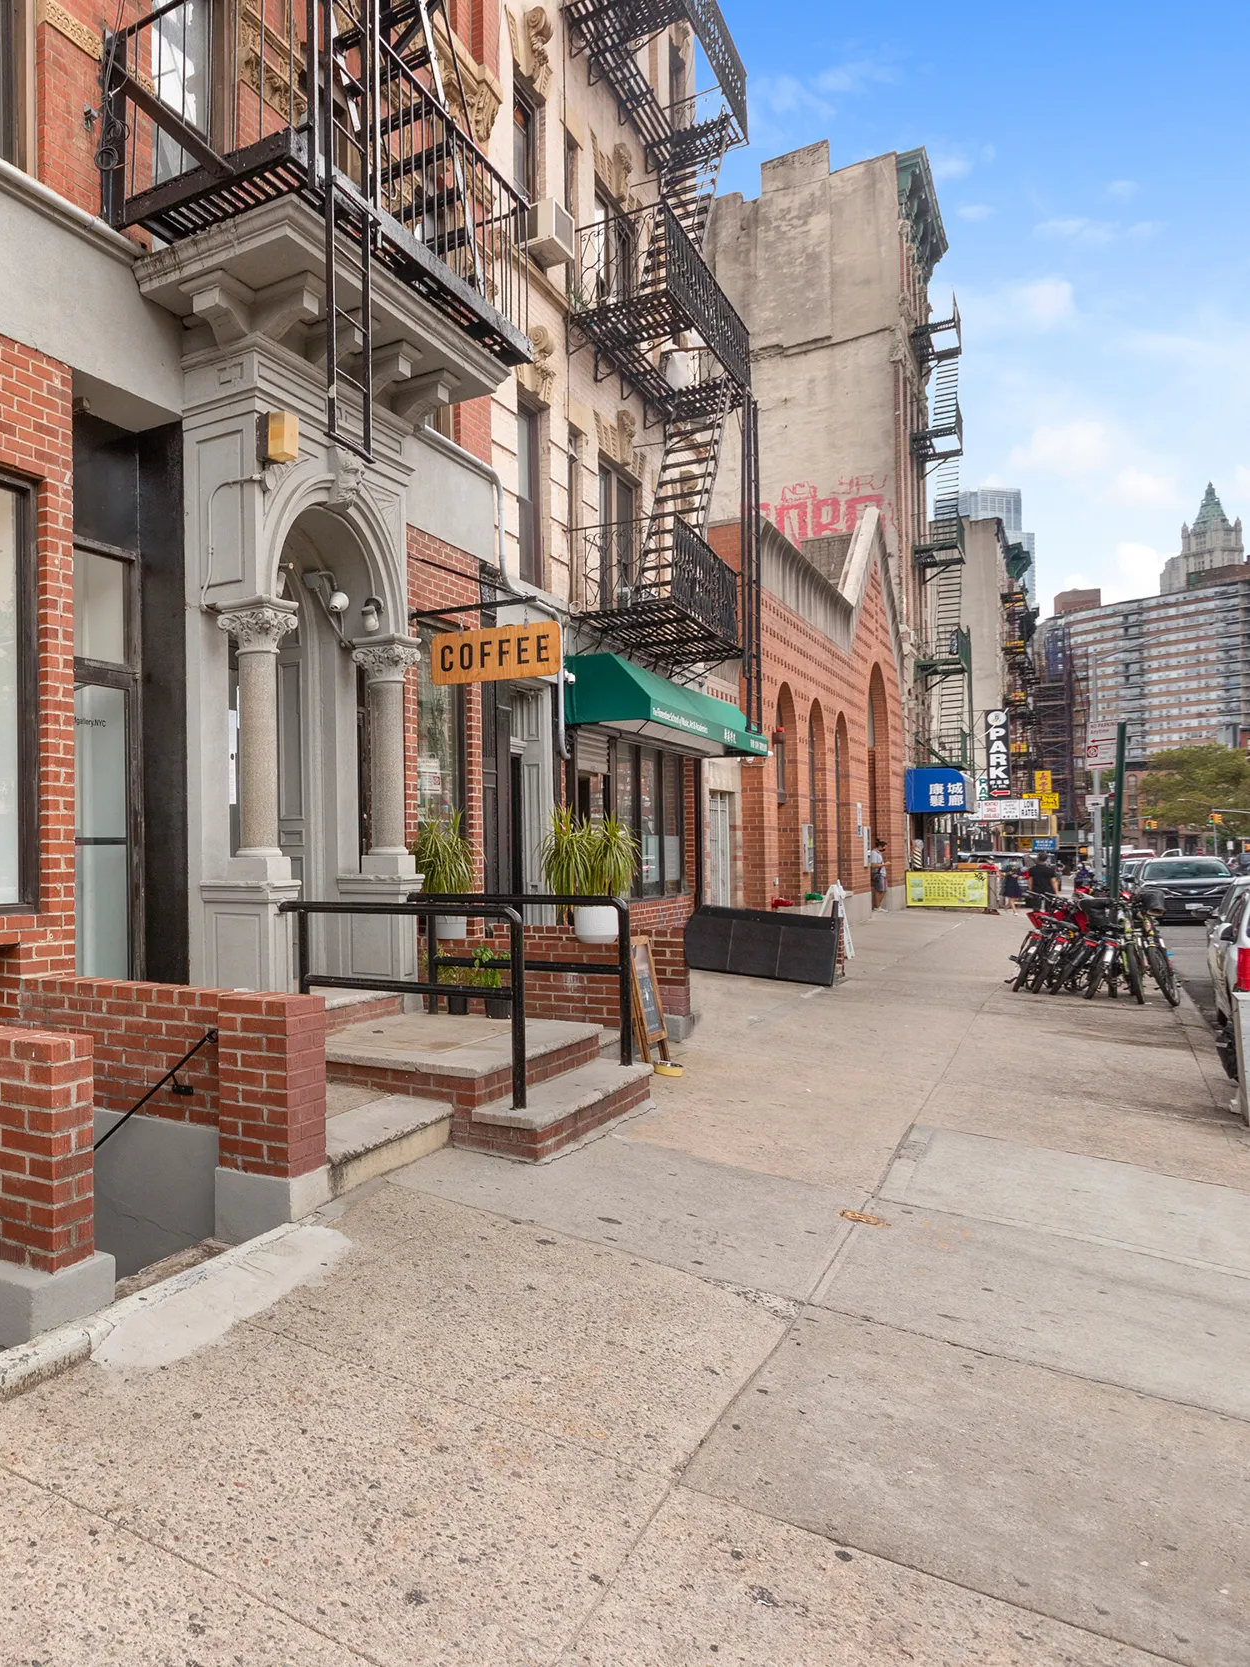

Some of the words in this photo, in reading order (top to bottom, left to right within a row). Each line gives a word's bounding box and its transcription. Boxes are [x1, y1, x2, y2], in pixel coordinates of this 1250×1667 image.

[440, 634, 550, 672] COFFEE
[74, 716, 107, 728] gallery.NYC
[989, 728, 1008, 779] PARK
[1023, 800, 1035, 808] LOW
[1021, 808, 1038, 817] RATES
